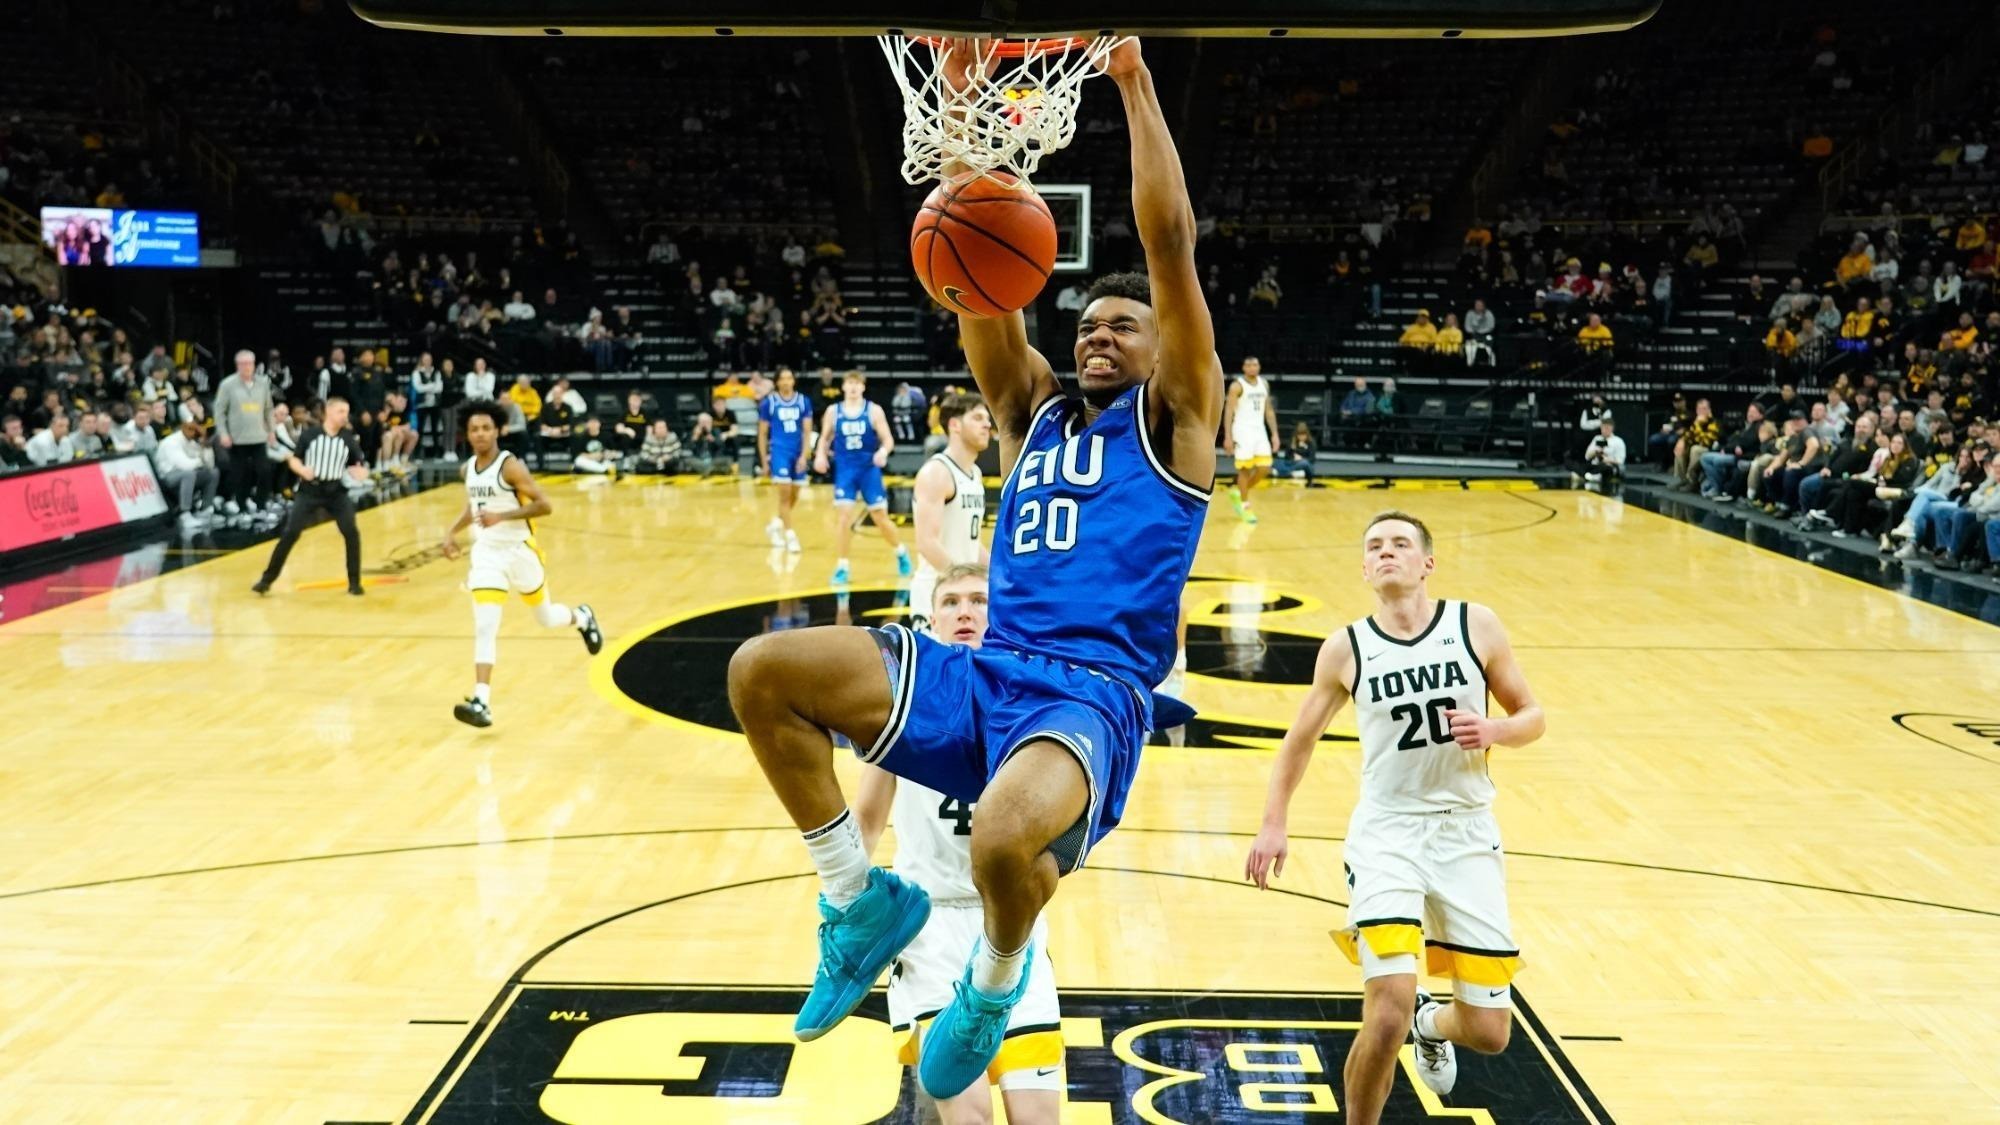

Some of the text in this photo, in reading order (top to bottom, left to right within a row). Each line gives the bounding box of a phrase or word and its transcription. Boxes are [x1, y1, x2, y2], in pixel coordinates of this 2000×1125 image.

[1016, 434, 1105, 494] EIU
[469, 486, 496, 497] OWA
[961, 494, 985, 509] IOW
[1013, 497, 1079, 555] 20
[1368, 660, 1468, 703] IOWA
[1390, 696, 1458, 751] 20
